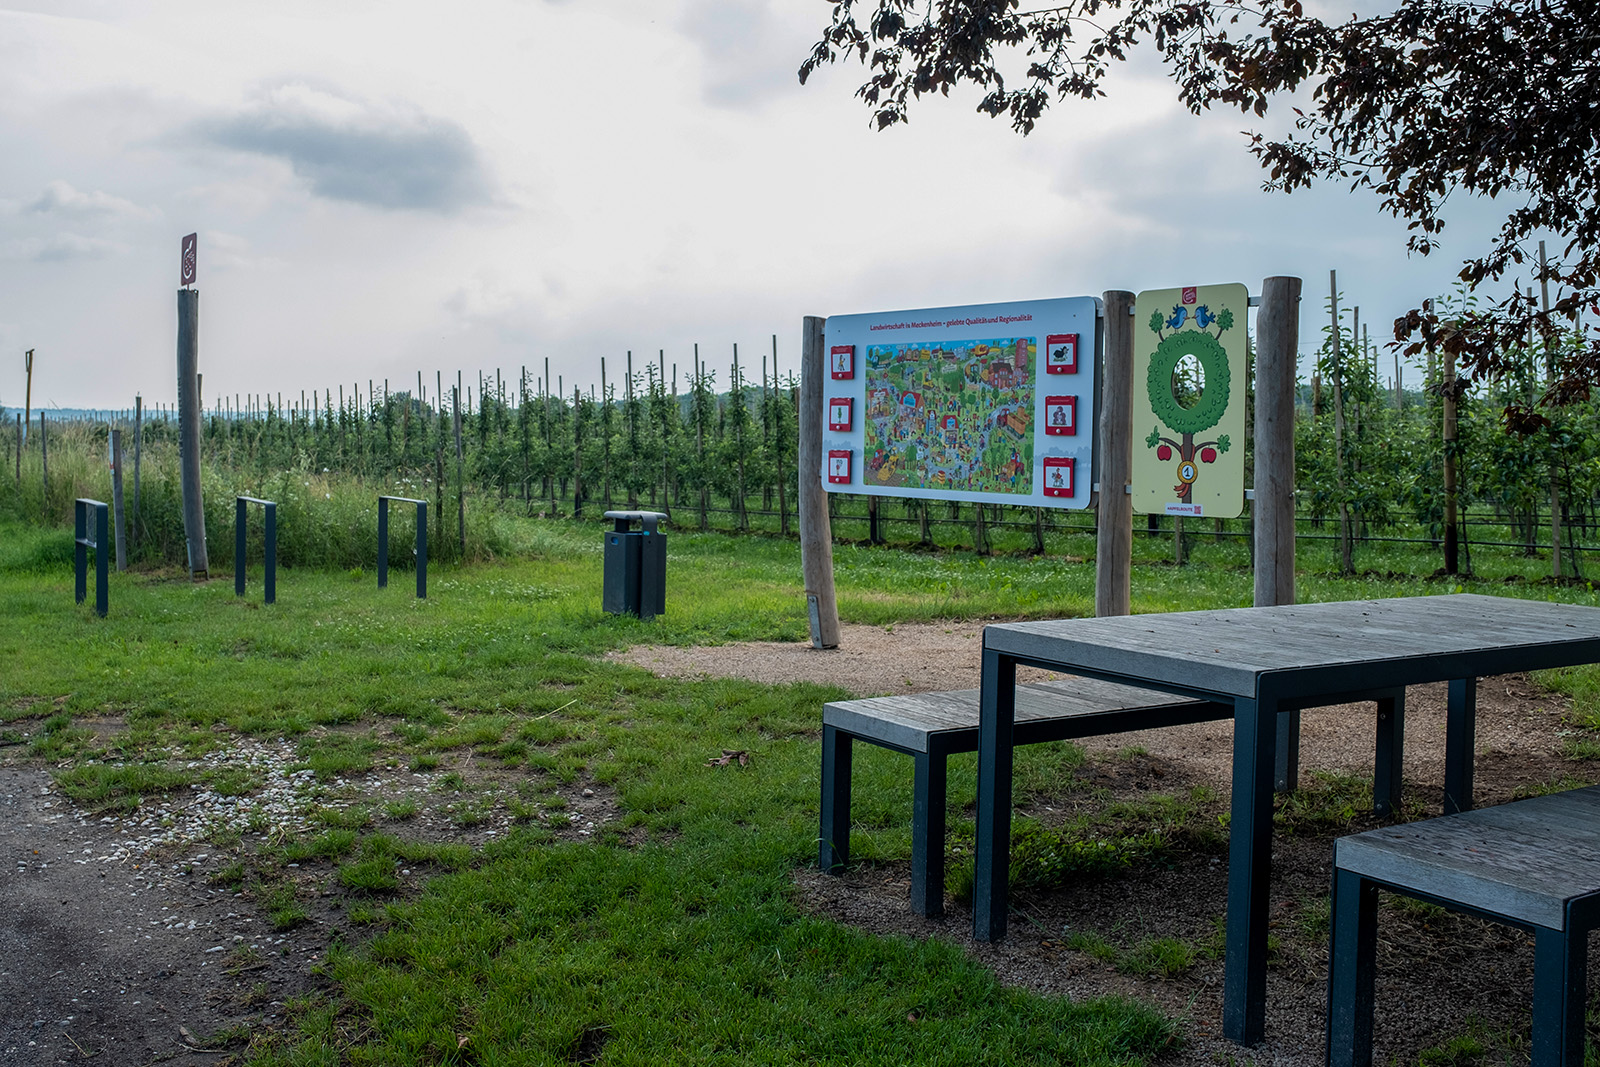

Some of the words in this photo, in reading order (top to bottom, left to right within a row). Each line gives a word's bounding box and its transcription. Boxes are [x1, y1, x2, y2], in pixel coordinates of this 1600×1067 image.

[870, 323, 905, 331] Landwirtschaft
[912, 320, 942, 328] Meckenheim
[946, 318, 965, 327] gelebte
[965, 317, 987, 326] Qualität
[999, 314, 1034, 324] Regionalität
[1184, 467, 1190, 476] 1
